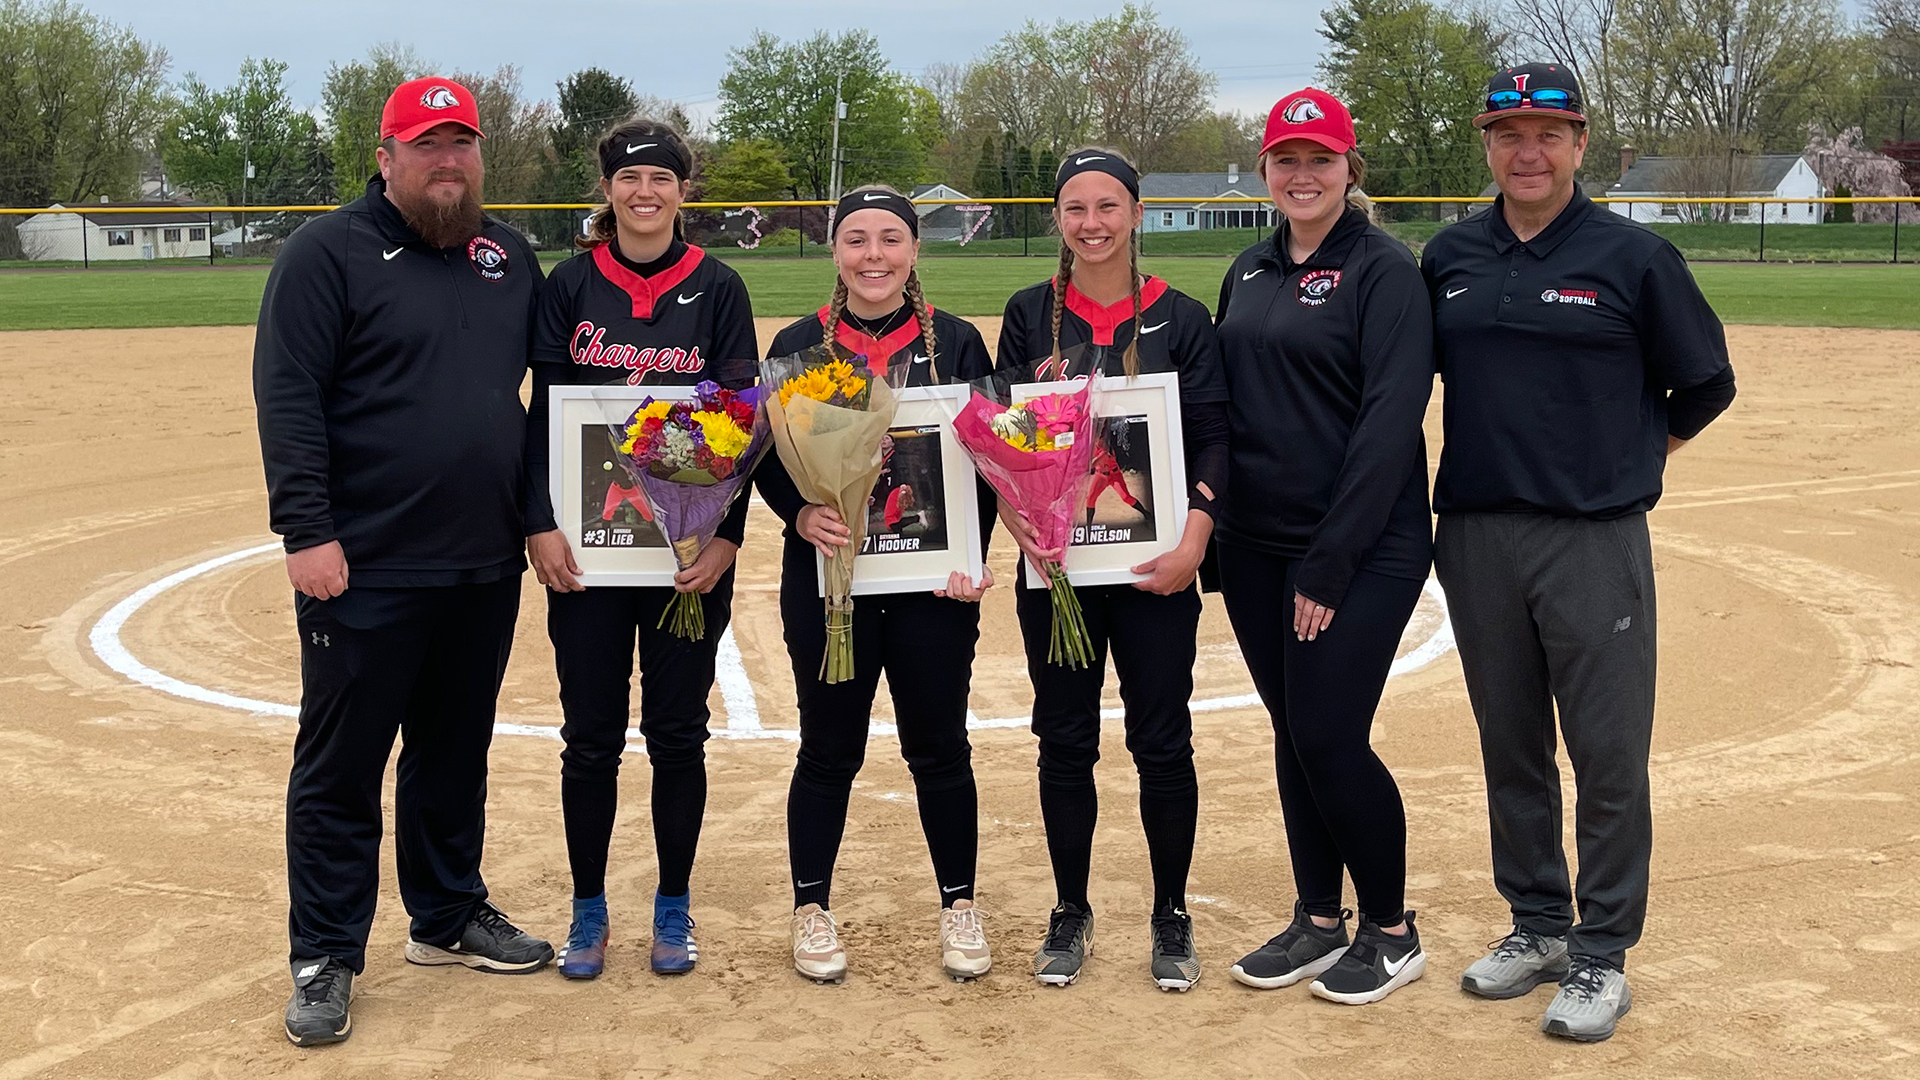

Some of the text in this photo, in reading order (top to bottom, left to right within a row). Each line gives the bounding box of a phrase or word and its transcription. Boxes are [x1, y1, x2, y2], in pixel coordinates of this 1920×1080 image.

[1558, 295, 1597, 306] SOFTBALL
[570, 320, 705, 386] Chargers
[583, 529, 606, 545] #3
[611, 534, 634, 545] LIEB
[1089, 528, 1131, 543] NELSON
[878, 537, 920, 552] HOOVER
